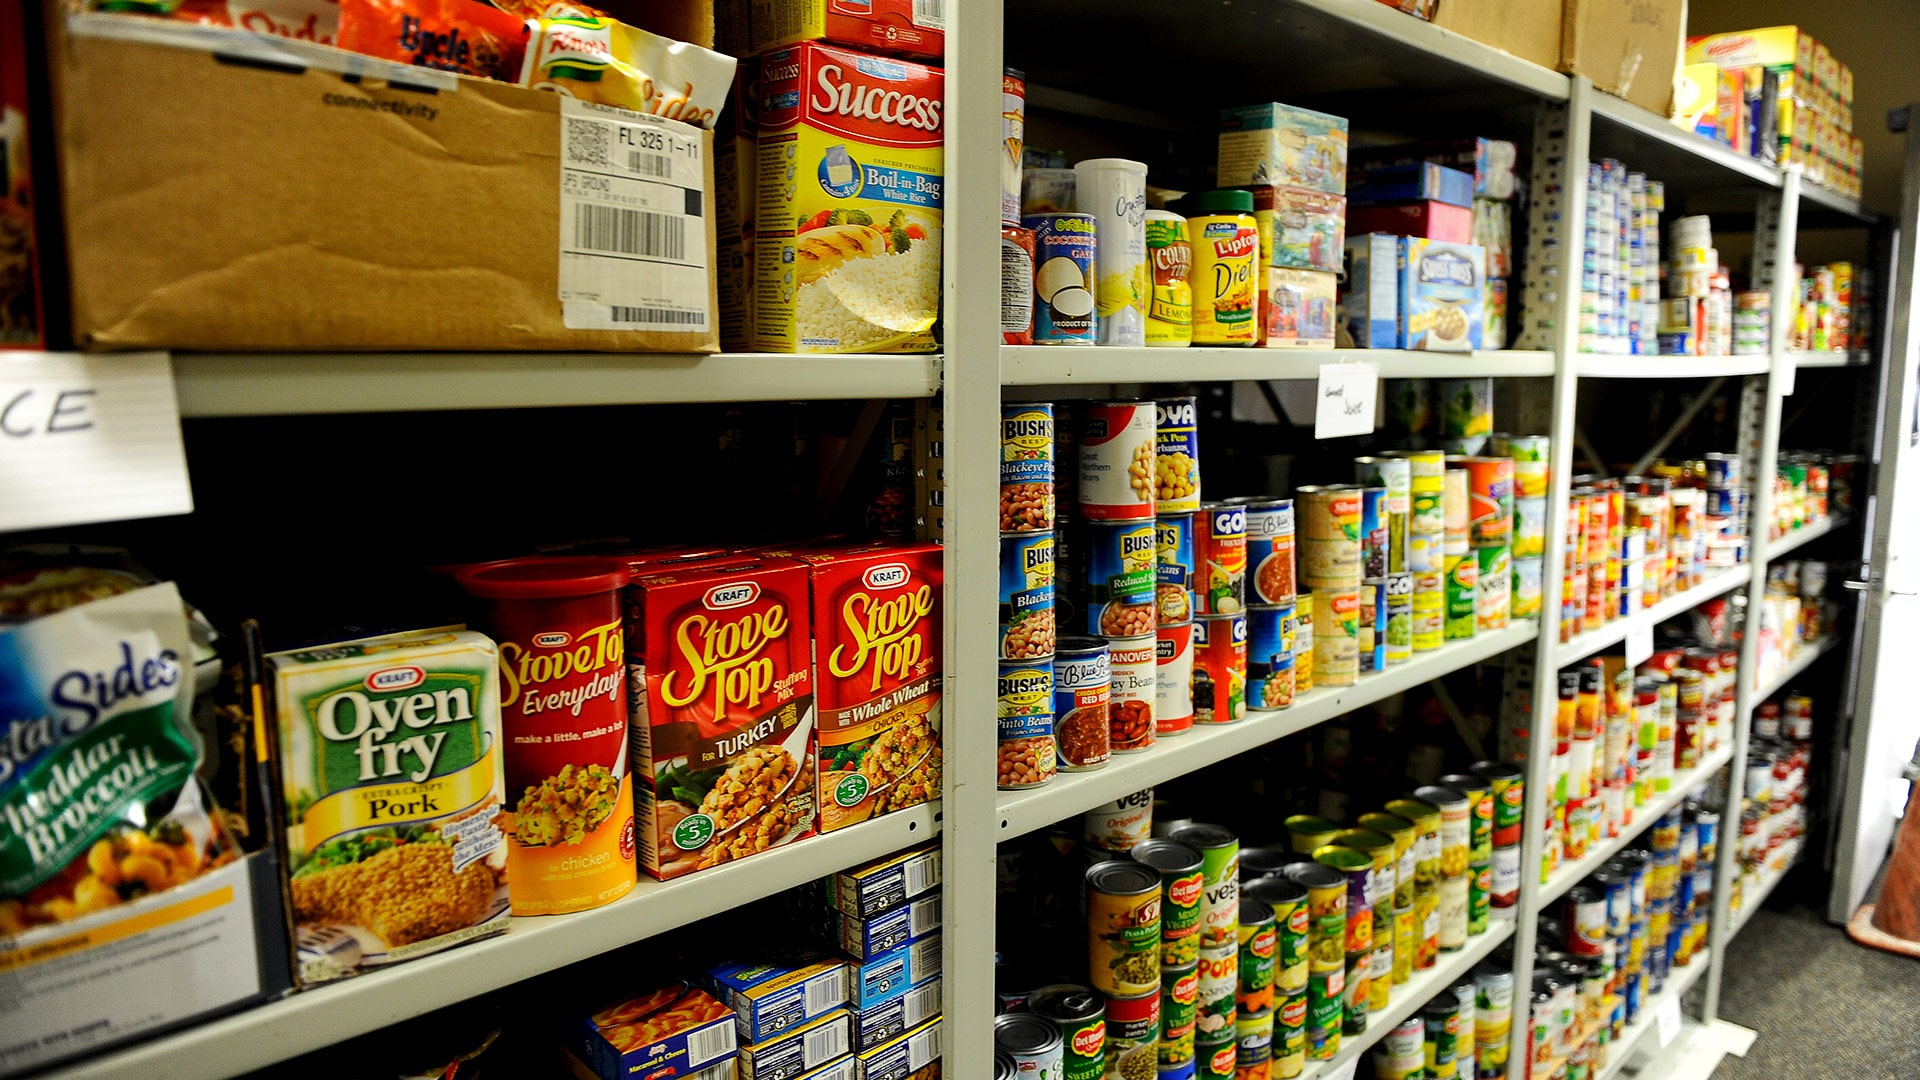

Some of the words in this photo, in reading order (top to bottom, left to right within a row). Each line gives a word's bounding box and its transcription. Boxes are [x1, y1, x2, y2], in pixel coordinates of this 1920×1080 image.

[400, 15, 469, 64] Uncle
[322, 92, 439, 120] connectivity
[811, 65, 942, 131] Success
[619, 127, 636, 147] FL
[867, 168, 941, 200] Boil-in-Bag
[883, 189, 908, 202] White
[909, 194, 927, 204] Rice
[1218, 234, 1258, 255] Lipton
[1211, 253, 1255, 300] Diet
[1156, 404, 1195, 425] OYA
[1215, 512, 1247, 535] GO
[873, 570, 902, 583] KRAFT
[714, 588, 750, 604] KRAFT
[541, 635, 565, 643] KRAFT
[829, 585, 934, 678] Stove
[661, 605, 788, 707] Stove
[868, 633, 922, 693] Top
[1110, 649, 1153, 663] ANOVER
[1156, 648, 1172, 656] ntry
[376, 670, 415, 685] KRAFT
[499, 642, 595, 708] Stove
[773, 669, 808, 694] Stuffing
[1063, 664, 1097, 687] Blue
[1156, 680, 1178, 688] rthern
[51, 642, 180, 738] Sides
[703, 656, 774, 724] Top
[777, 687, 795, 703] Mix
[852, 697, 892, 723] Whole
[892, 679, 930, 705] Wheat
[1081, 695, 1097, 705] RED
[317, 687, 474, 741] Oven
[873, 709, 907, 732] CHICKEN
[515, 735, 543, 744] make
[582, 727, 608, 740] make
[702, 752, 716, 762] FOR
[715, 715, 778, 759] TURKEY
[354, 731, 447, 783] fry
[0, 733, 125, 836] heddar
[361, 787, 400, 801] EXTRA
[847, 784, 857, 797] 5
[25, 745, 159, 864] Broccoli
[369, 794, 439, 820] Pork
[444, 804, 500, 837] Homestyle
[688, 824, 701, 840] 5
[561, 852, 610, 871] chicken
[1075, 1036, 1088, 1047] Del
[629, 1056, 660, 1074] Macaroni
[664, 1048, 687, 1061] Cheese
